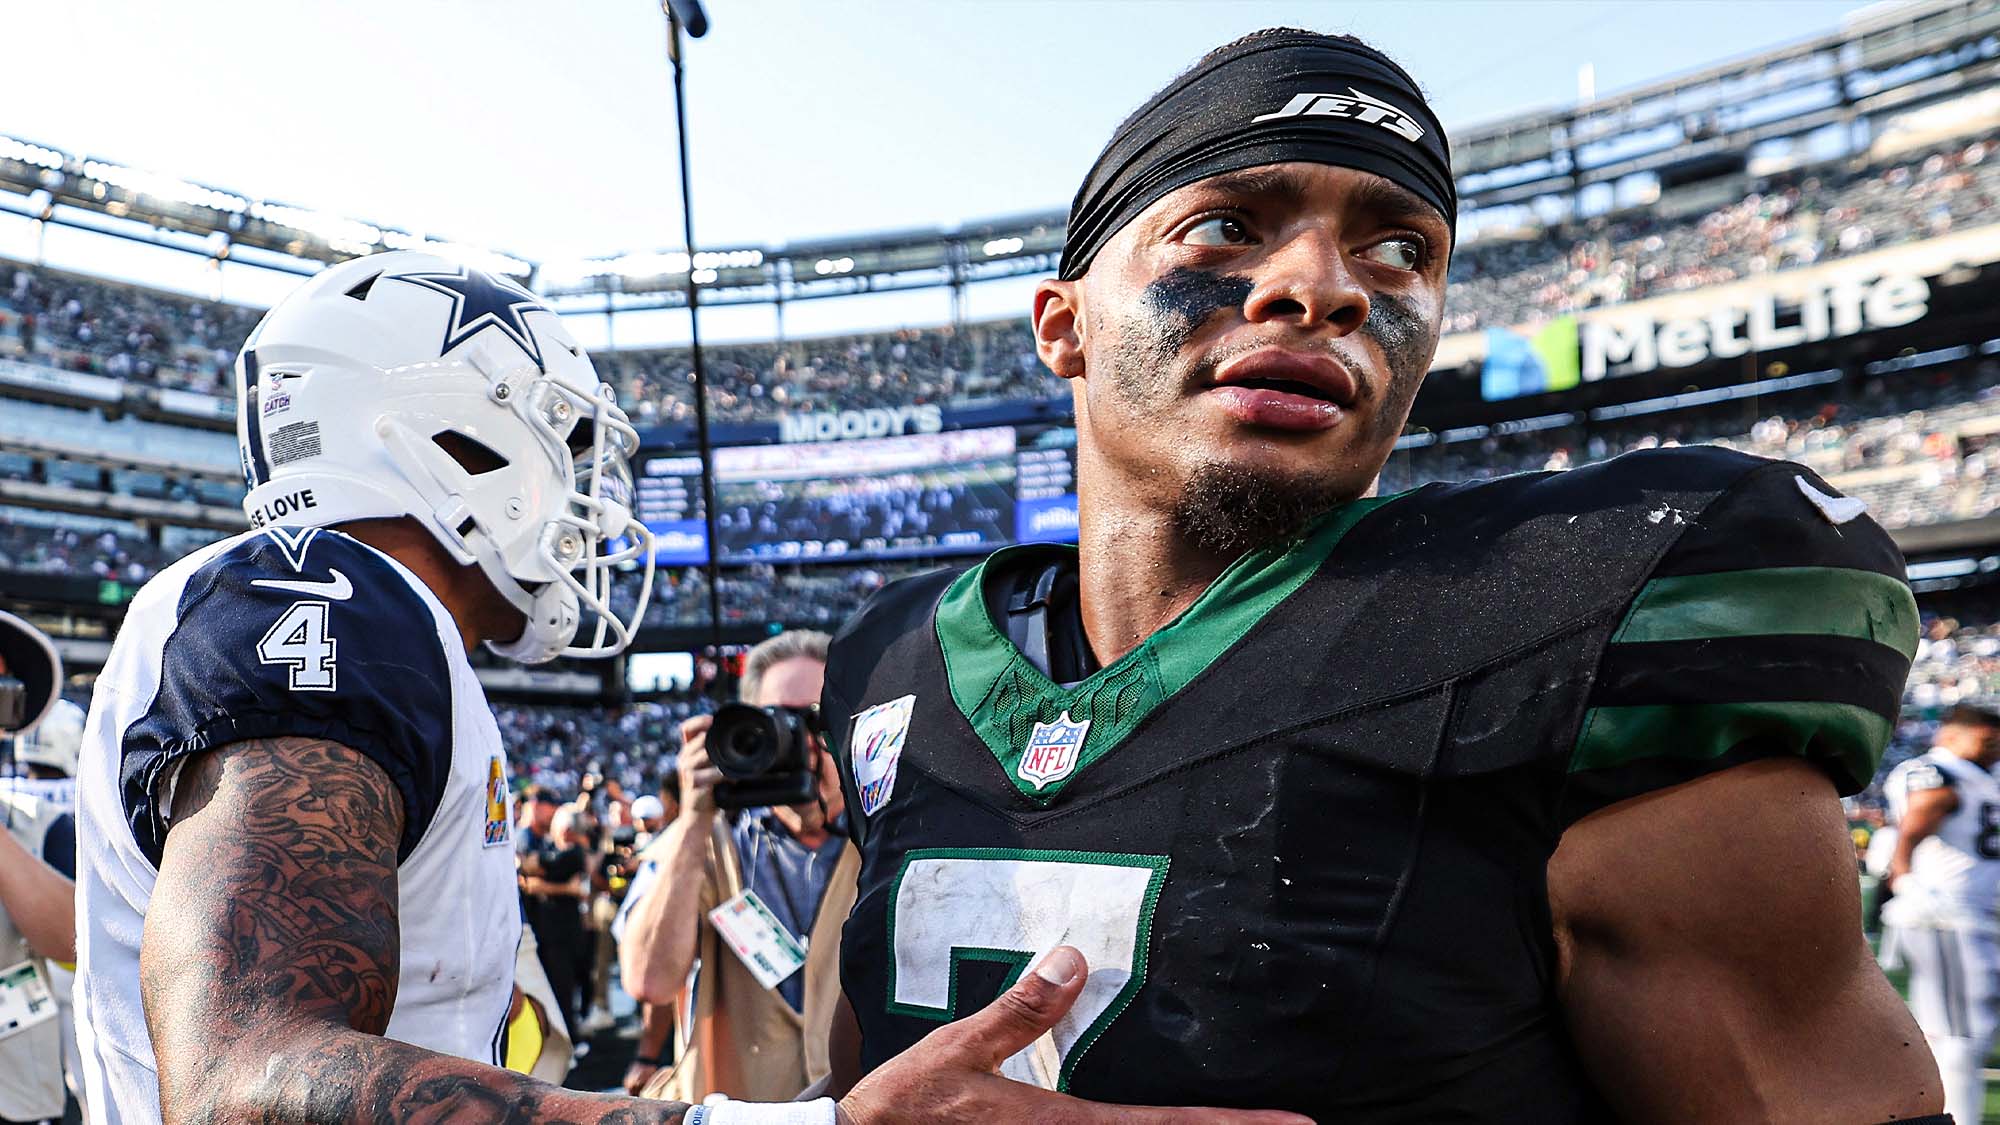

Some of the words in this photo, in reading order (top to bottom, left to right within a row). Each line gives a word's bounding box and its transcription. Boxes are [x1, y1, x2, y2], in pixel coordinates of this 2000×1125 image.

[1251, 87, 1425, 142] JETS
[1581, 271, 1931, 382] MetLife
[780, 403, 943, 443] MOODY'S
[250, 509, 266, 529] SE
[264, 489, 317, 521] LOVE
[256, 600, 337, 692] 4
[1027, 746, 1067, 774] NFL
[887, 848, 1171, 1094] 7
